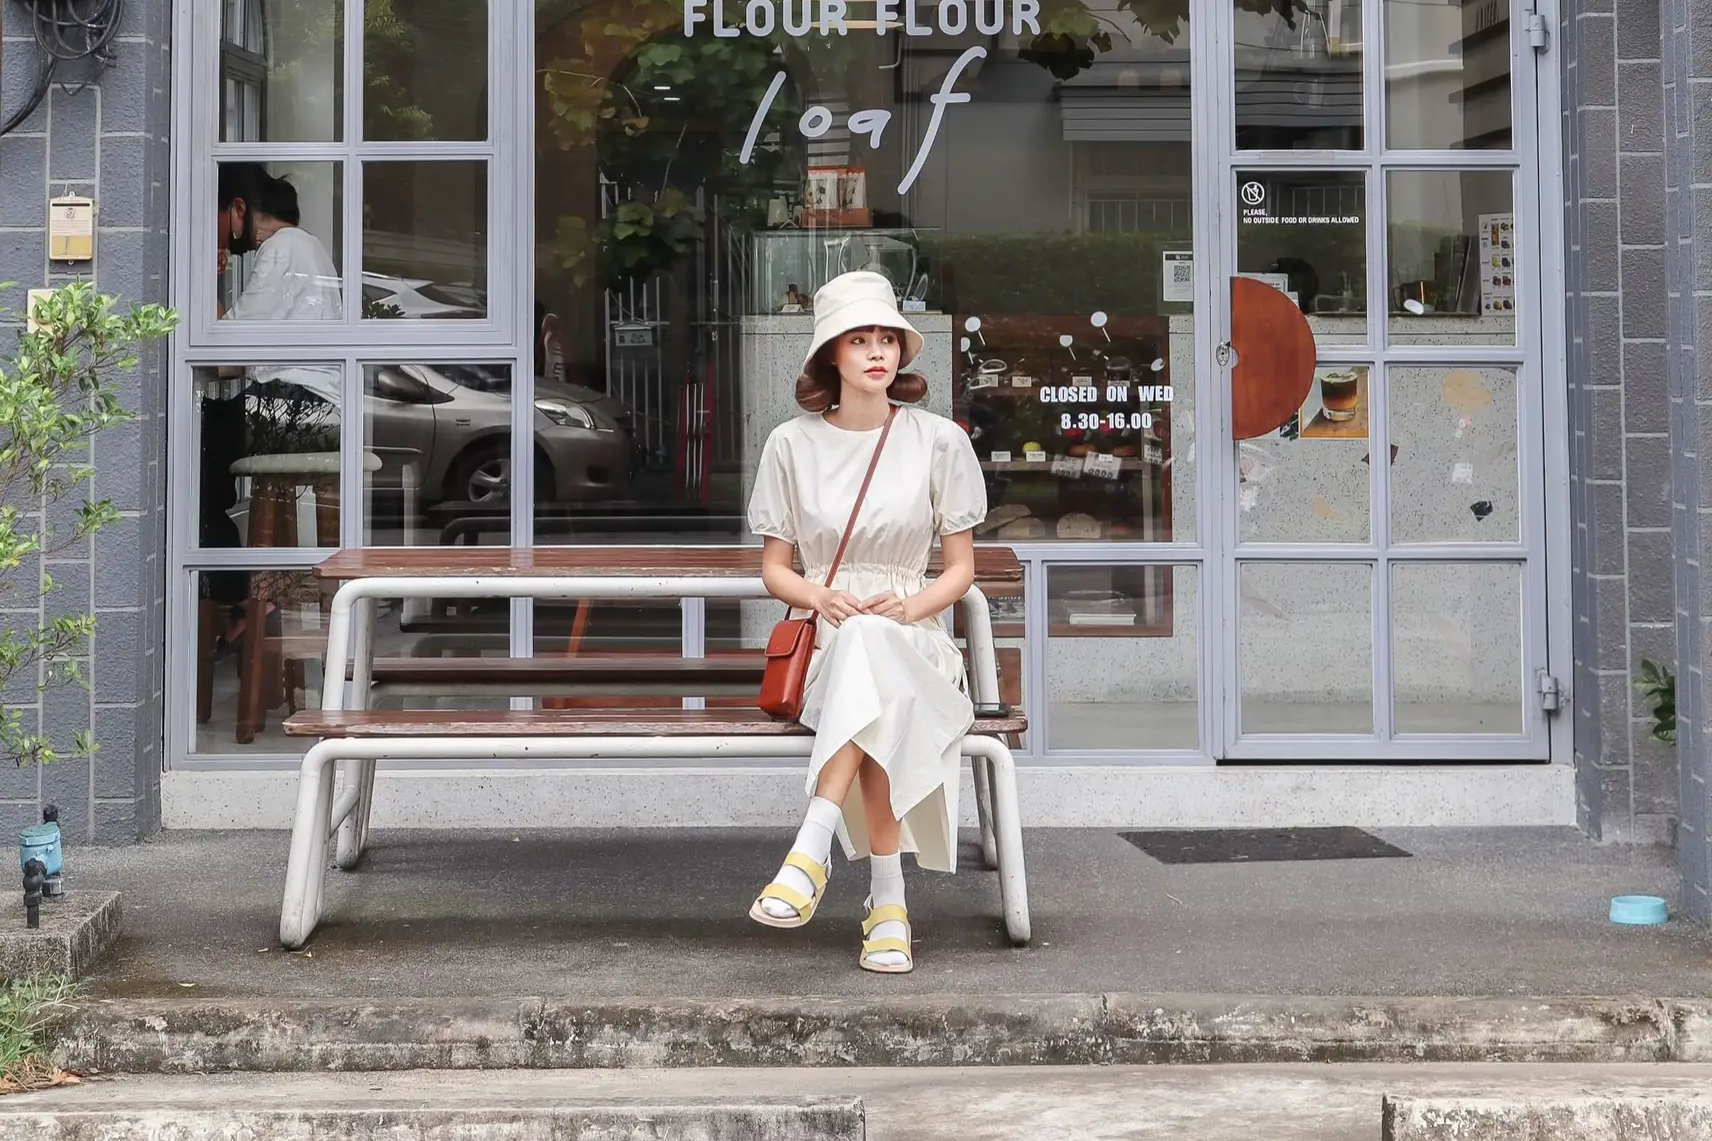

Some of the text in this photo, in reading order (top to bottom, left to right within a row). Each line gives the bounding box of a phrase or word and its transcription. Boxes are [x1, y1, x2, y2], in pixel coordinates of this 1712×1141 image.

[739, 45, 987, 195] loaf
[1040, 385, 1174, 402] CLOSED ON WED
[1061, 413, 1152, 429] 8.30-16.00
